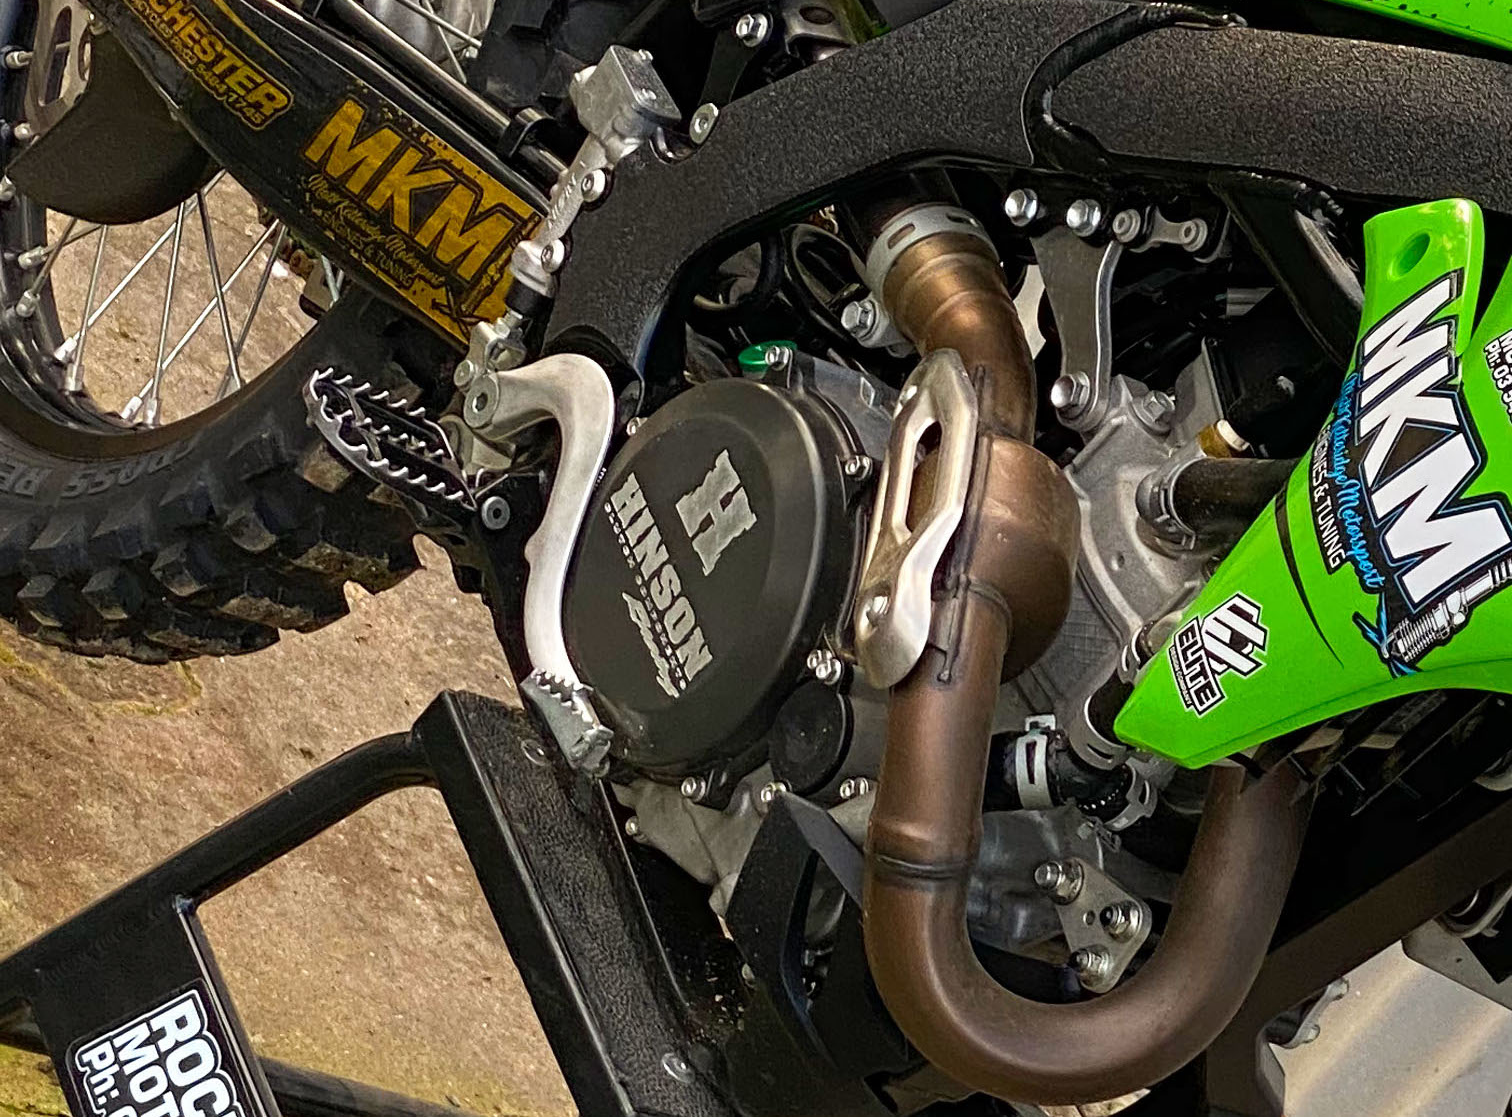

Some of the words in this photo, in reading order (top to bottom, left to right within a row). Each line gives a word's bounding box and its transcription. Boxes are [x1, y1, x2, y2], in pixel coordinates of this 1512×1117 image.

[304, 98, 516, 282] MKM
[1484, 339, 1503, 367] Ph:
[1357, 278, 1512, 605] MKM
[609, 471, 714, 683] HINSON
[1314, 497, 1347, 569] TUNING
[1335, 478, 1386, 590] Motorsport
[1177, 622, 1218, 708] ELITE
[82, 1040, 116, 1106] Ph:
[152, 996, 242, 1117] ROC
